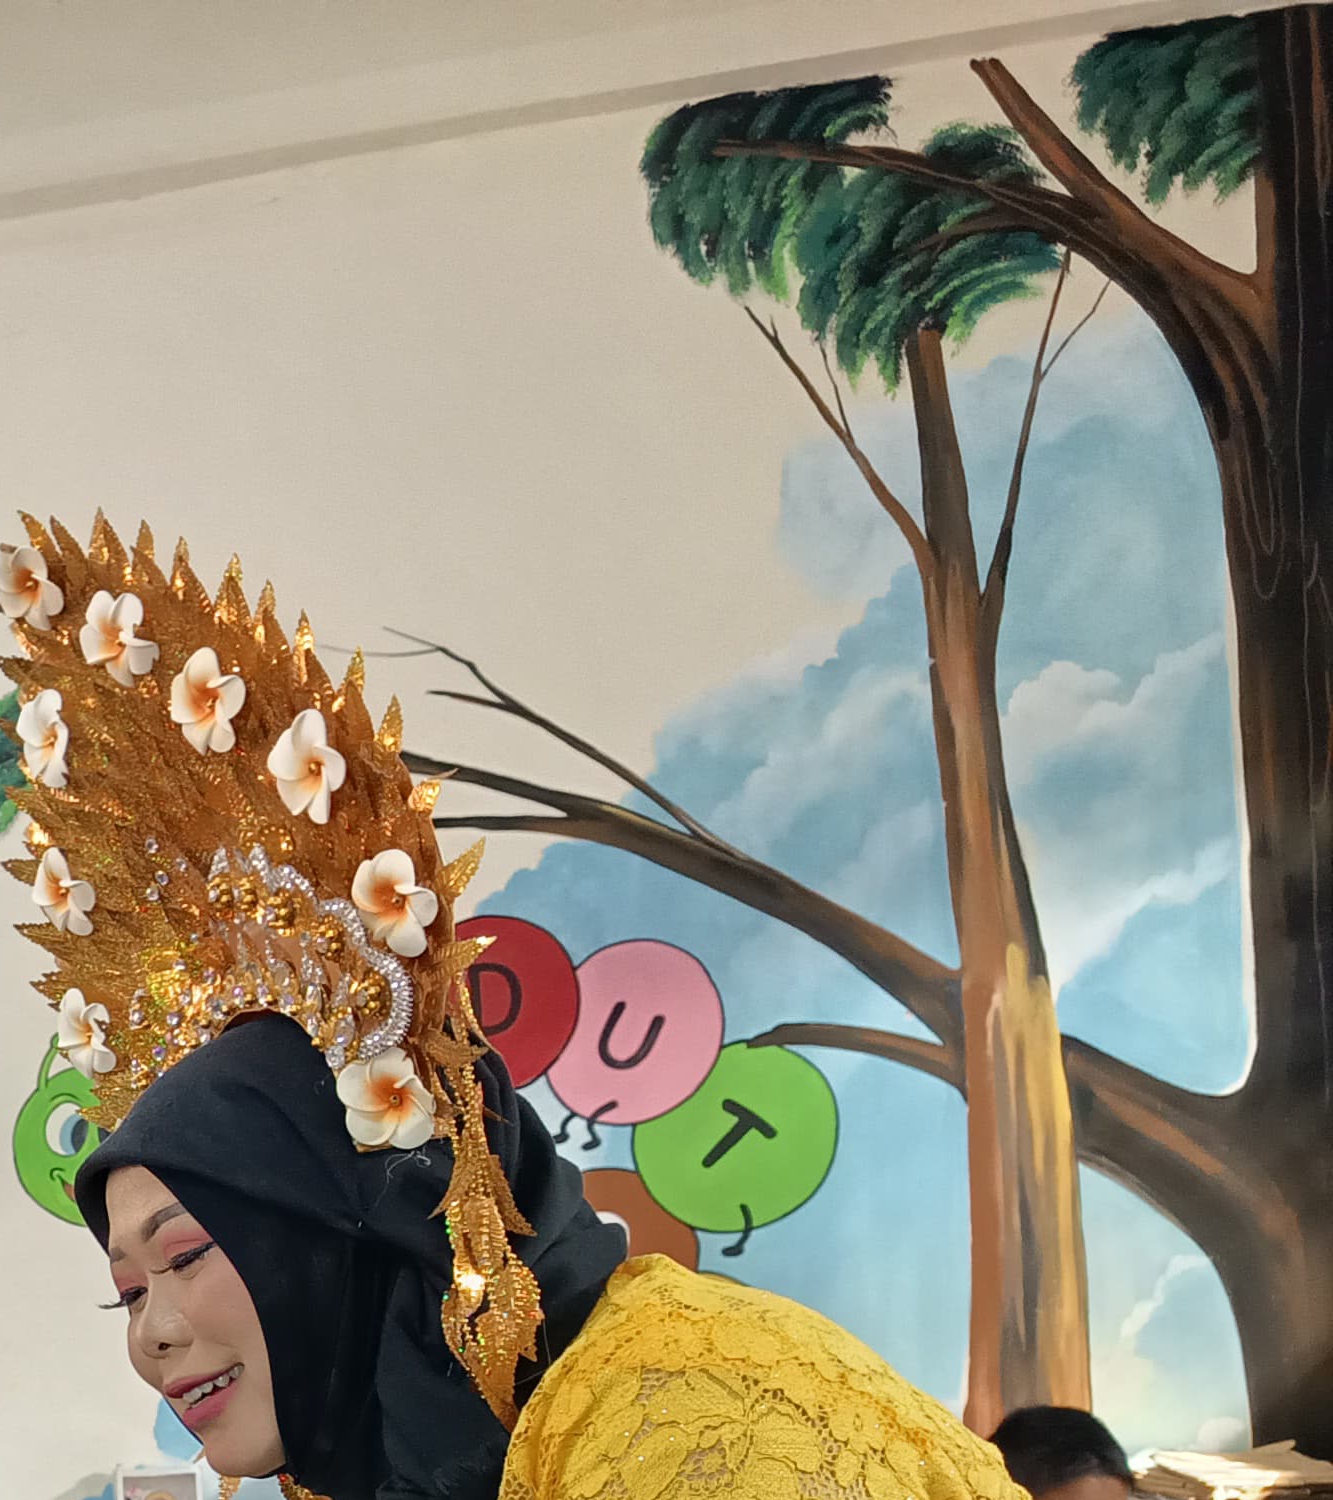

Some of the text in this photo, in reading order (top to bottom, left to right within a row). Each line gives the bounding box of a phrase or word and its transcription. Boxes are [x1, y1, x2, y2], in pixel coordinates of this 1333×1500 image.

[467, 962, 778, 1168] D U T
